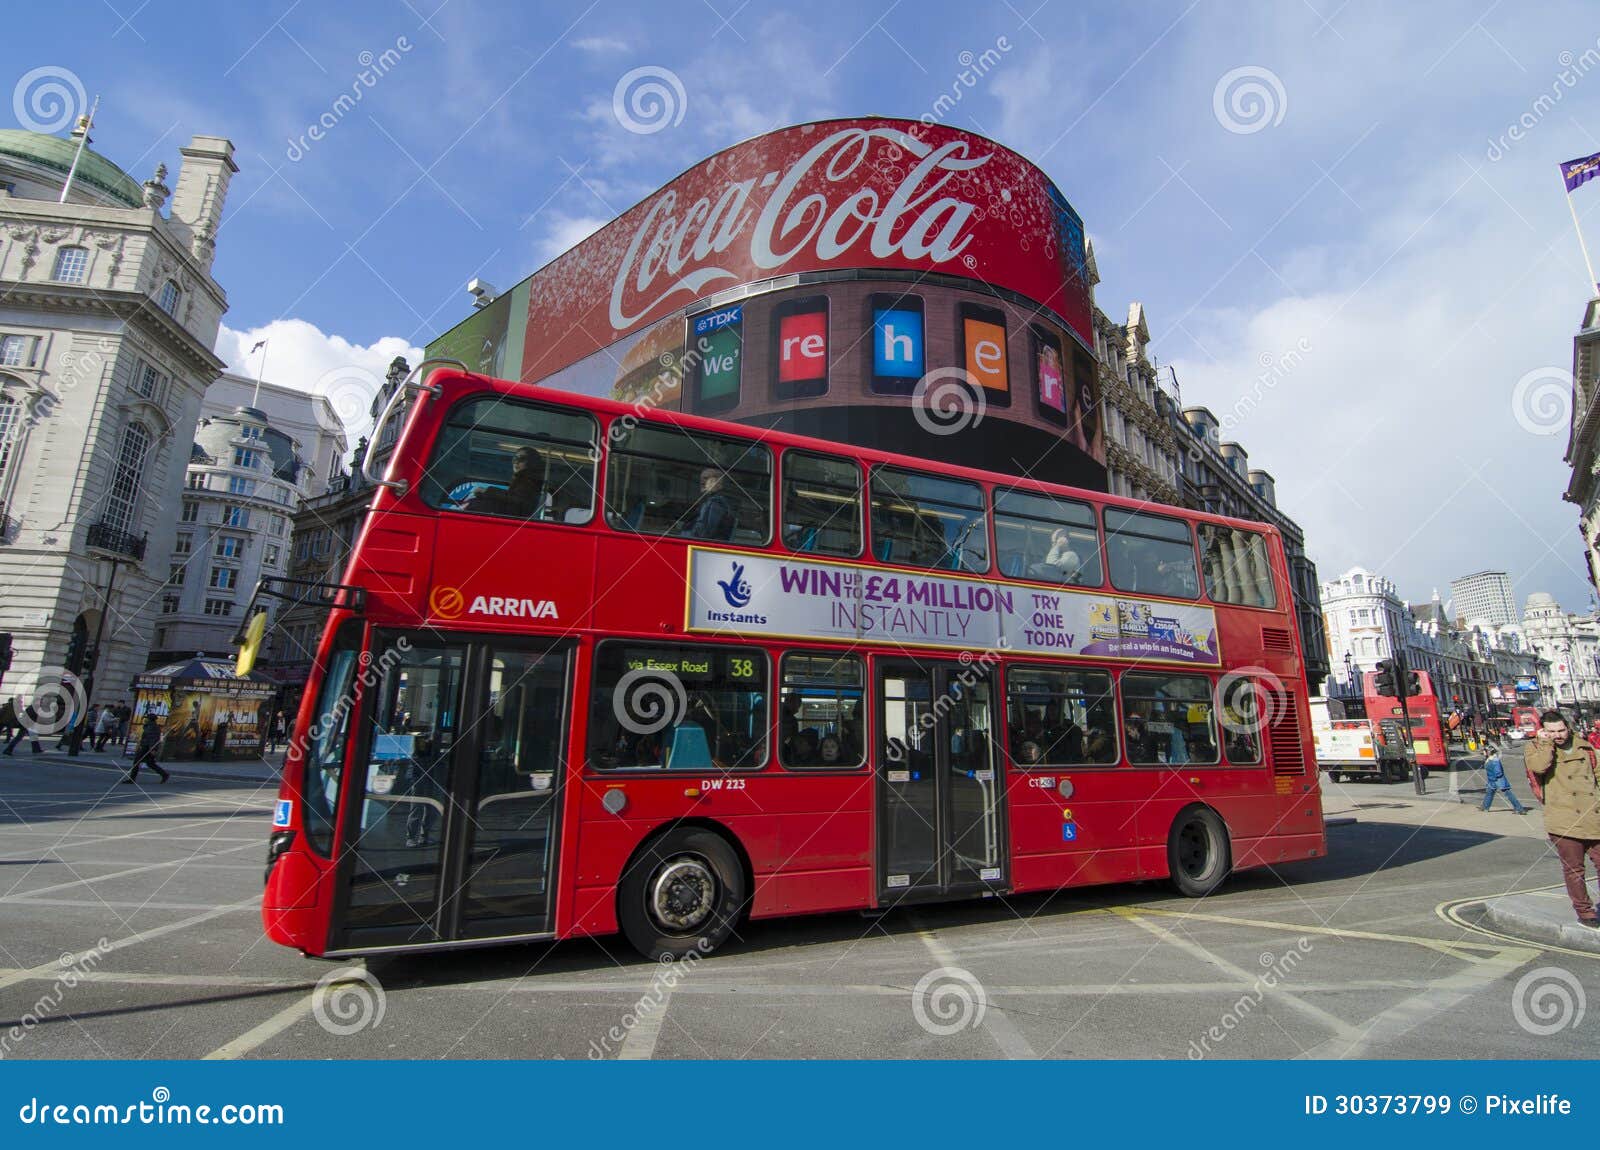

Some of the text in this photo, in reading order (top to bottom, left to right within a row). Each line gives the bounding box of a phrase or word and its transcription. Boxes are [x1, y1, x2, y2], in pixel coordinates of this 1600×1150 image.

[608, 128, 994, 330] Coca-Cola
[706, 309, 738, 328] TDK
[780, 566, 1014, 614] WIN UP £4 MILLION
[844, 586, 863, 600] TO
[468, 595, 559, 619] ARRIVA
[1031, 594, 1060, 612] TRY
[707, 610, 767, 625] Instants
[832, 601, 971, 638] INSTANTLY
[1032, 612, 1064, 630] ONE
[1024, 630, 1075, 649] TODAY
[628, 659, 708, 673] via Essex Road
[731, 659, 753, 677] 38
[702, 779, 746, 790] DW 223
